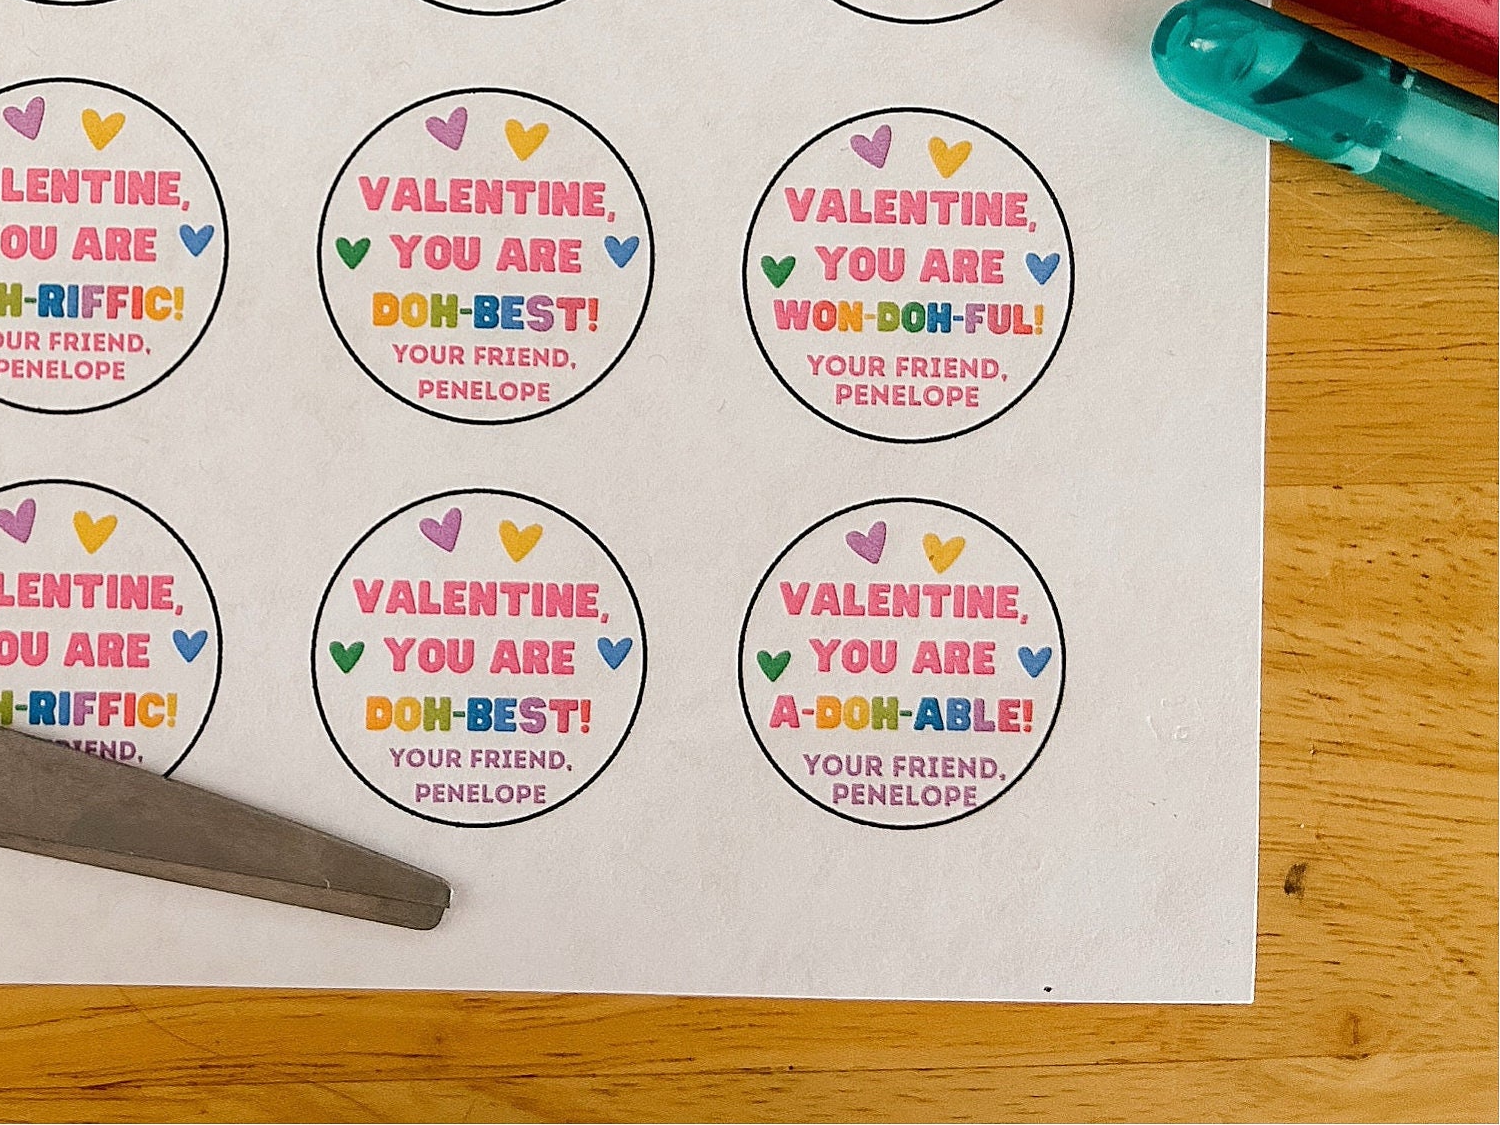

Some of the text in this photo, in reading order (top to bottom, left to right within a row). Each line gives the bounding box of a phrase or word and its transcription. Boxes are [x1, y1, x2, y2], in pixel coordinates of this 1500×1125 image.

[358, 176, 615, 223] VALENTINE,
[784, 187, 1036, 233] VALENTINE,
[72, 227, 157, 263] ARE
[390, 234, 582, 274] YOU ARE
[815, 246, 1005, 285] YOU ARE
[372, 292, 599, 332] DOH-BEST!
[773, 299, 1045, 337] WON-DOH-FUL!
[49, 332, 151, 355] FRIEND,
[393, 344, 576, 370] YOUR FRIEND,
[807, 355, 1007, 382] YOUR FRIEND,
[418, 380, 550, 402] PENELOPE
[836, 384, 979, 408] PENELOPE
[353, 579, 609, 624] VALENTINE,
[780, 582, 1028, 625] VALENTINE,
[63, 632, 150, 669] ARE
[383, 637, 575, 676] YOU ARE
[809, 639, 996, 676] YOU ARE
[365, 696, 592, 735] DOH-BEST!
[769, 695, 1034, 733] A-DOH-ABLE!
[390, 748, 572, 772] YOUR FRIEND,
[803, 754, 1006, 781] YOUR FRIEND,
[416, 783, 546, 804] PENELOPE
[833, 784, 977, 808] PENELOPE
